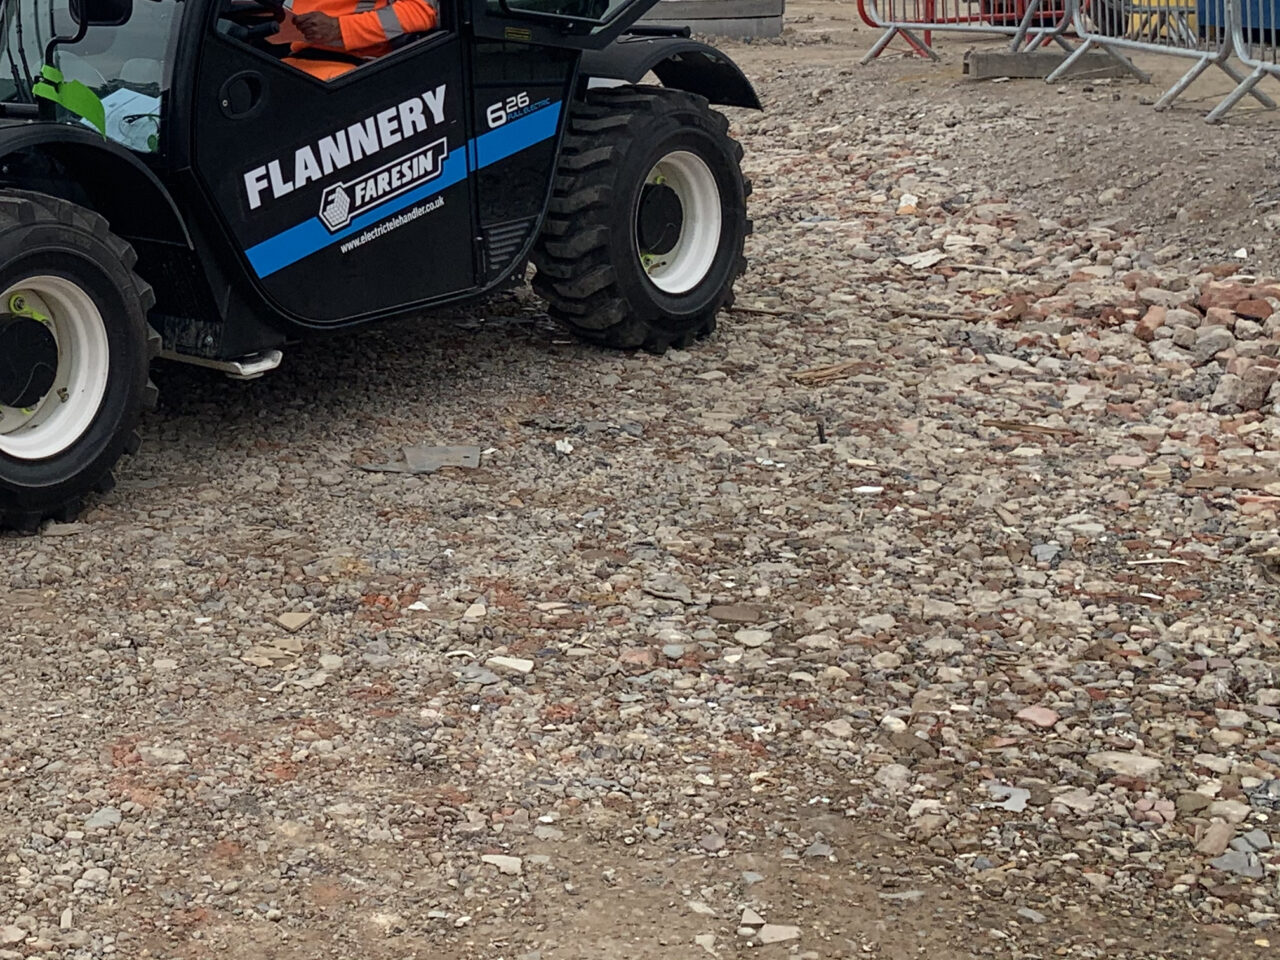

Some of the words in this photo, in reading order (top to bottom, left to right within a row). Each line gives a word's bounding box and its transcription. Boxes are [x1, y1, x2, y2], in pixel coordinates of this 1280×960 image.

[243, 84, 446, 210] FLANNERY
[354, 149, 434, 208] FARESIN
[340, 195, 445, 254] www.electrictelehandler.co.uk
